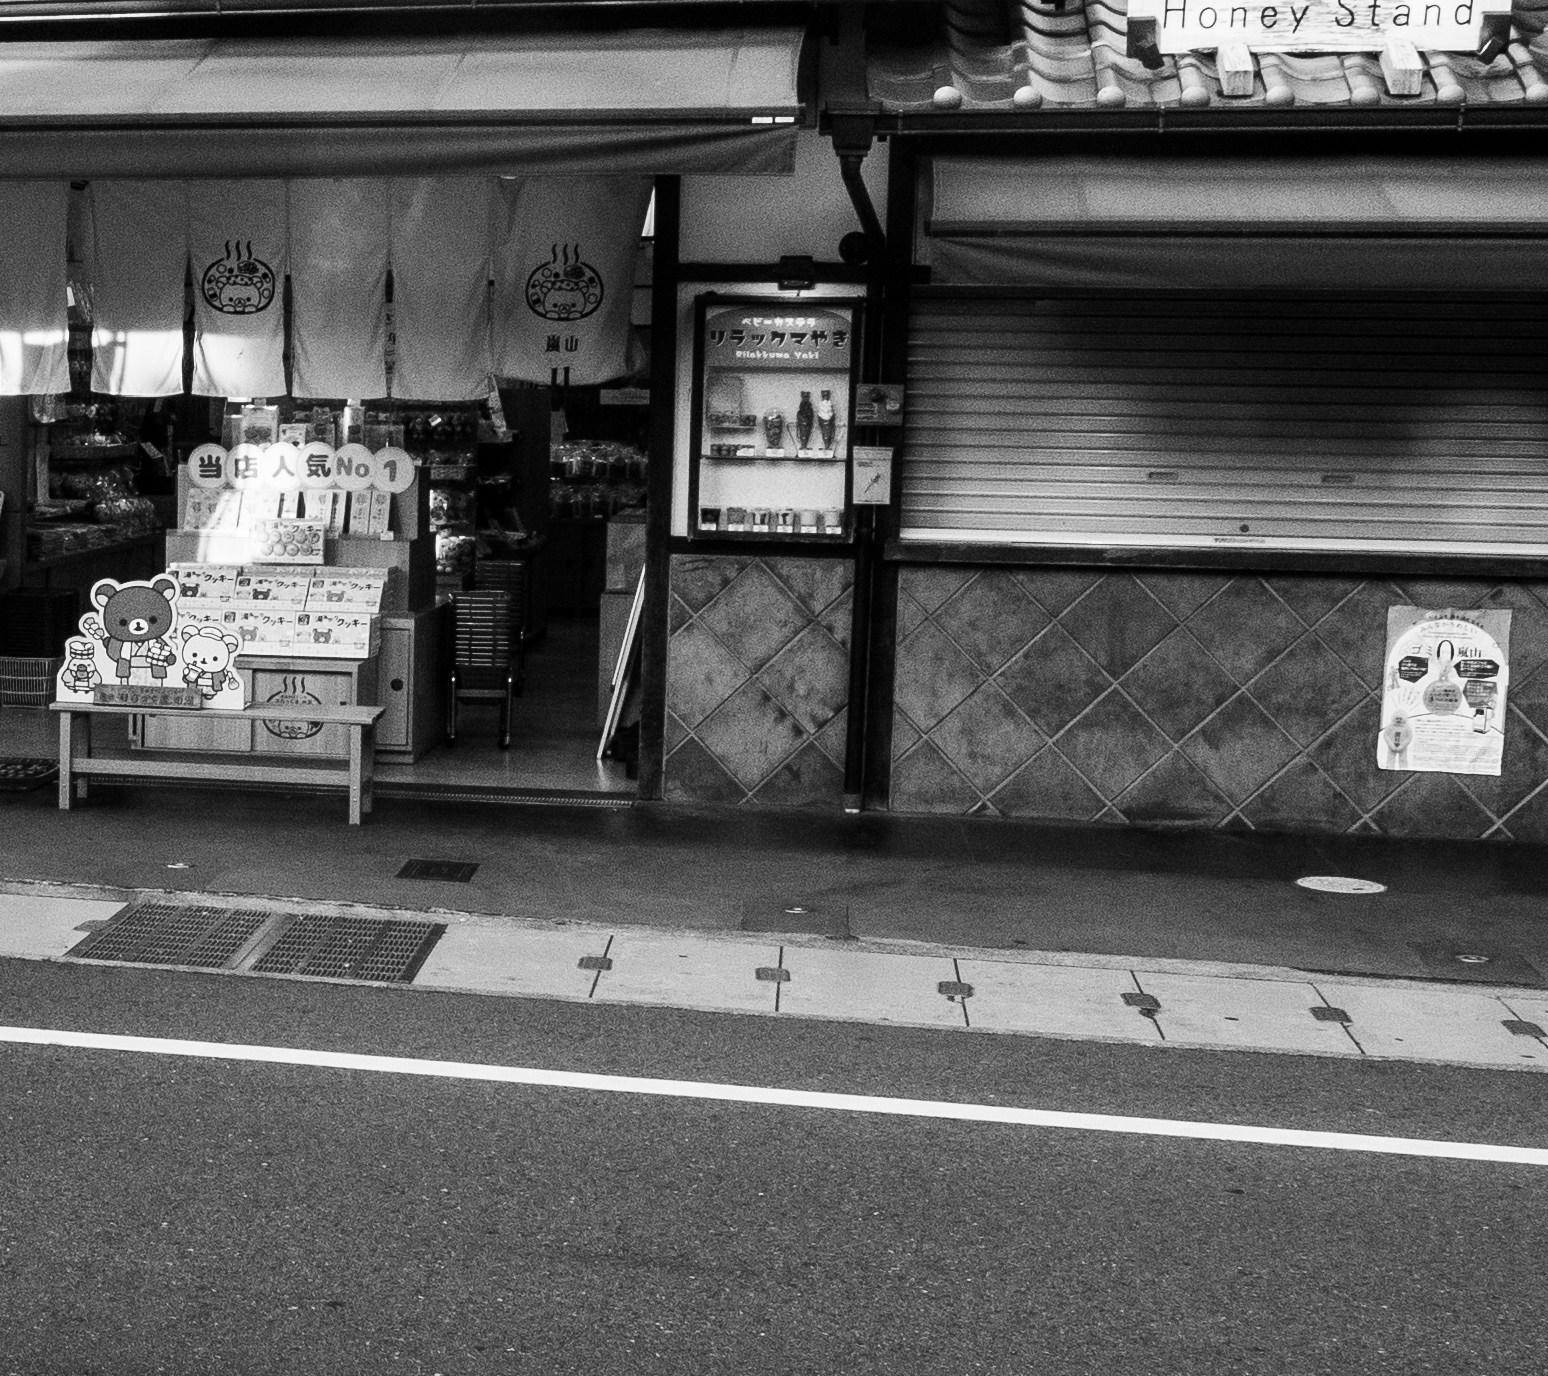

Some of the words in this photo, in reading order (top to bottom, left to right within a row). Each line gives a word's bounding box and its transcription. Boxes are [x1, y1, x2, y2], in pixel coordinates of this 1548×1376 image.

[740, 317, 816, 328] ベビーカステラ
[545, 334, 580, 353] 嵐山
[709, 328, 850, 349] リラックマやき
[735, 350, 791, 360] Rilakkuma
[795, 350, 820, 360] Yaki
[1457, 645, 1483, 659] 嵐山
